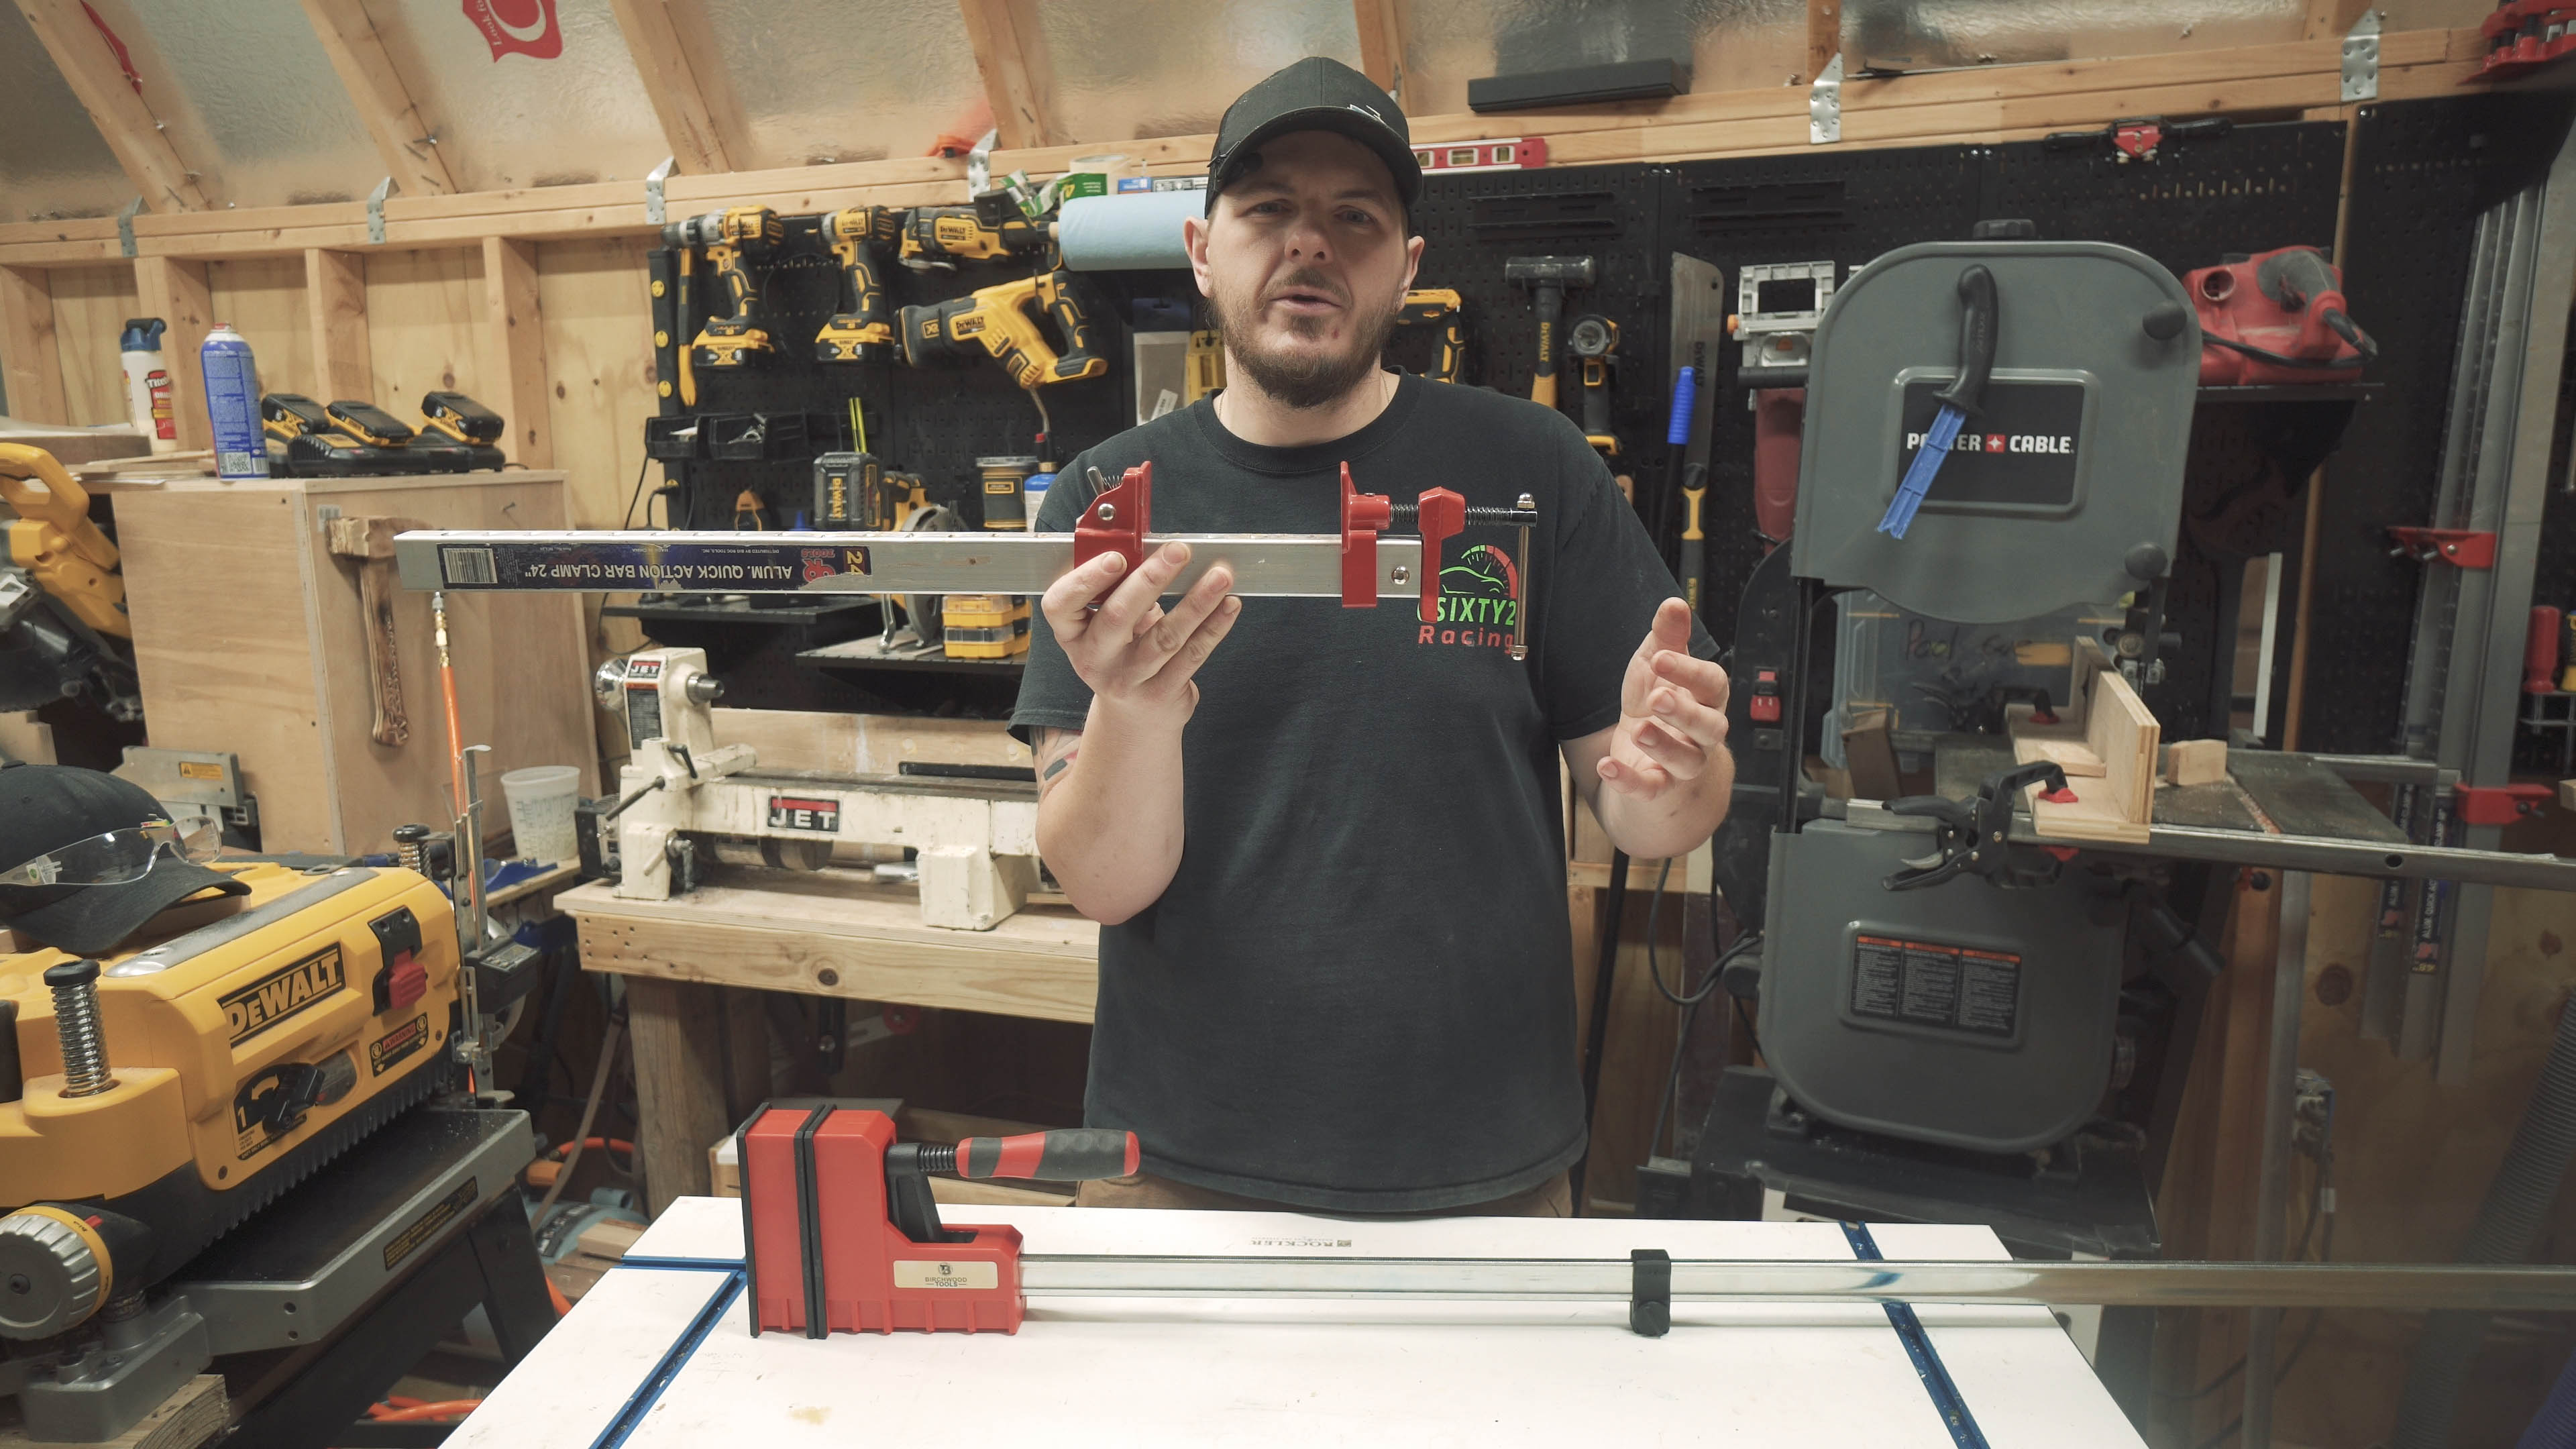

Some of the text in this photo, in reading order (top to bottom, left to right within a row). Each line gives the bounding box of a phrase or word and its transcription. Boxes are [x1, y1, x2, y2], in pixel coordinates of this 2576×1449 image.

[1906, 432, 2072, 453] PER CABLE
[832, 478, 843, 519] DEWALT
[525, 564, 792, 580] ALUM. QUICK ACTION BAR CLAMP 24"
[1417, 625, 1515, 655] Racing
[771, 809, 836, 828] JET
[224, 953, 339, 1036] DEWALT
[237, 1106, 248, 1128] 1
[1250, 1239, 1334, 1247] ROCKLER
